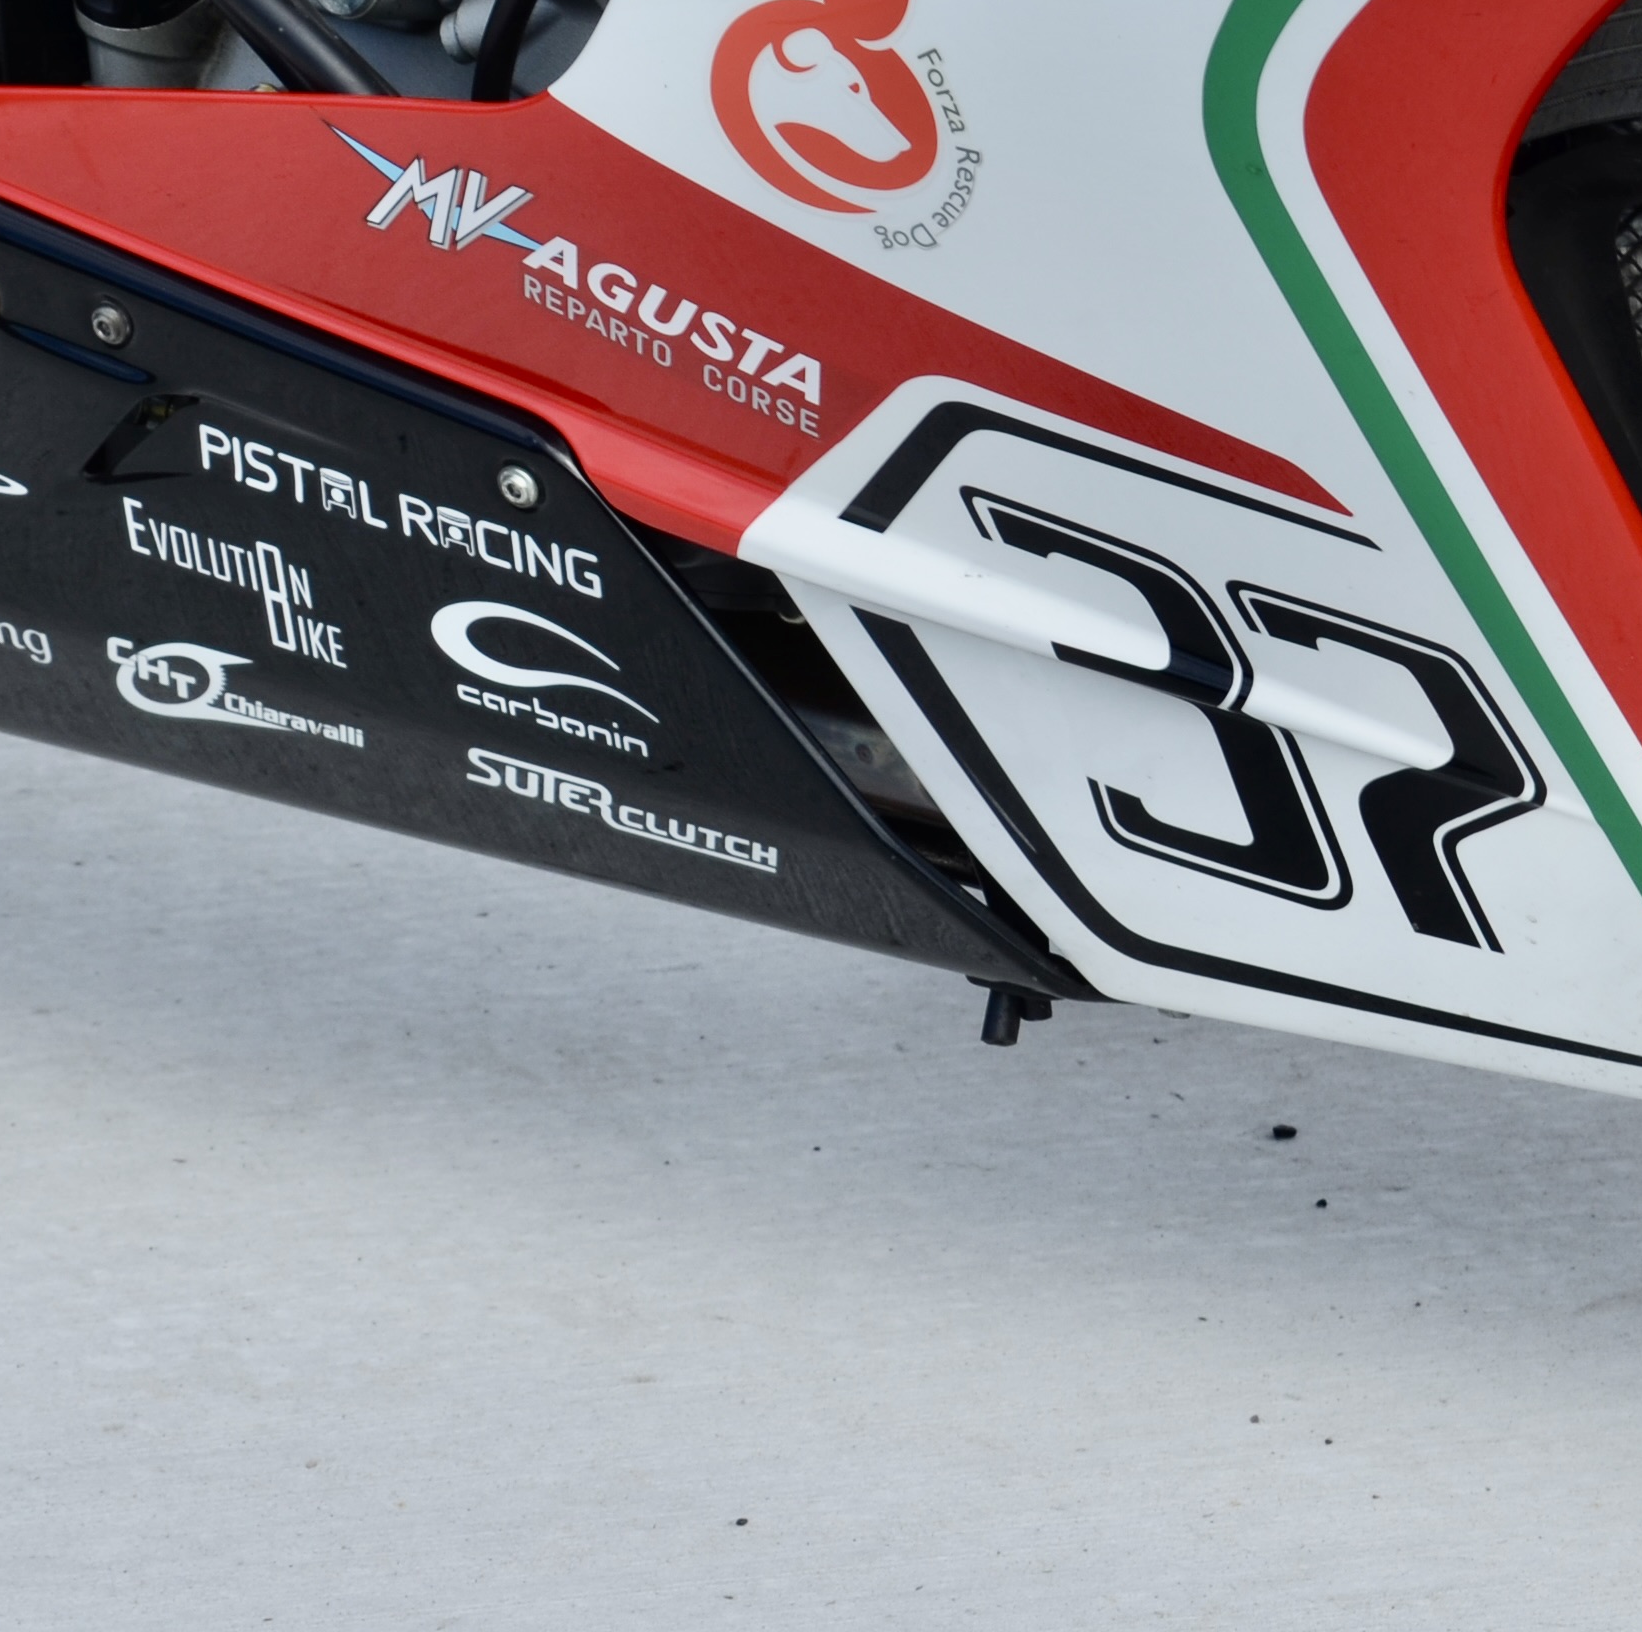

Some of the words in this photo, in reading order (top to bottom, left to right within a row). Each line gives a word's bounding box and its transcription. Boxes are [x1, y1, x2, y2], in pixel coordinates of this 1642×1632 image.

[916, 45, 966, 135] Forza
[933, 143, 983, 232] Rescue
[872, 220, 939, 251] Dog
[365, 156, 534, 249] MV
[523, 235, 822, 406] AGUSTA
[523, 272, 674, 368] REPARTO
[703, 363, 822, 439] CORSE
[106, 636, 197, 699] CHT
[223, 691, 366, 749] Chiaravalli
[456, 683, 650, 758] carbonin
[957, 483, 1547, 956] 37
